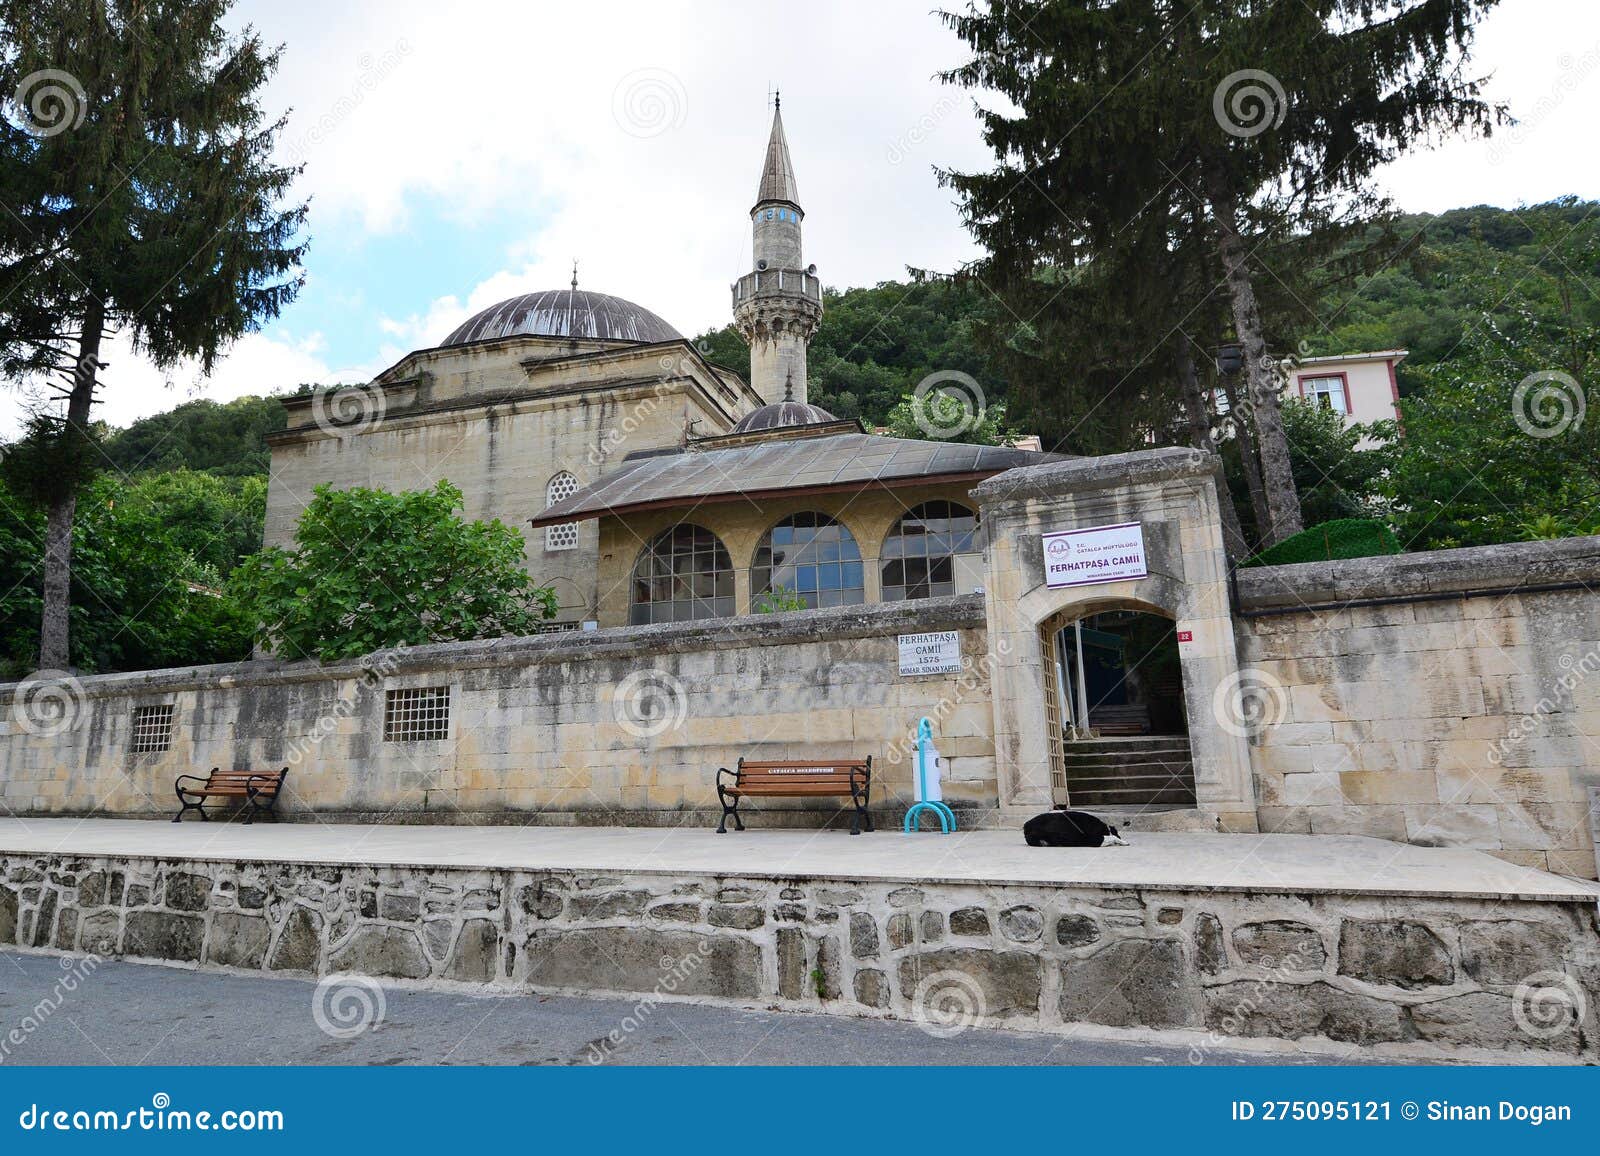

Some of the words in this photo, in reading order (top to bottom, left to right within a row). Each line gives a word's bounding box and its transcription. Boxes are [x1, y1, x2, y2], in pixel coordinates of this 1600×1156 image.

[1050, 558, 1110, 573] FERHATPAŞA
[1112, 553, 1140, 566] CAMİİ
[900, 633, 956, 645] FERHATPAŞA
[915, 643, 941, 655] CAMİİ
[919, 656, 940, 664] 1575
